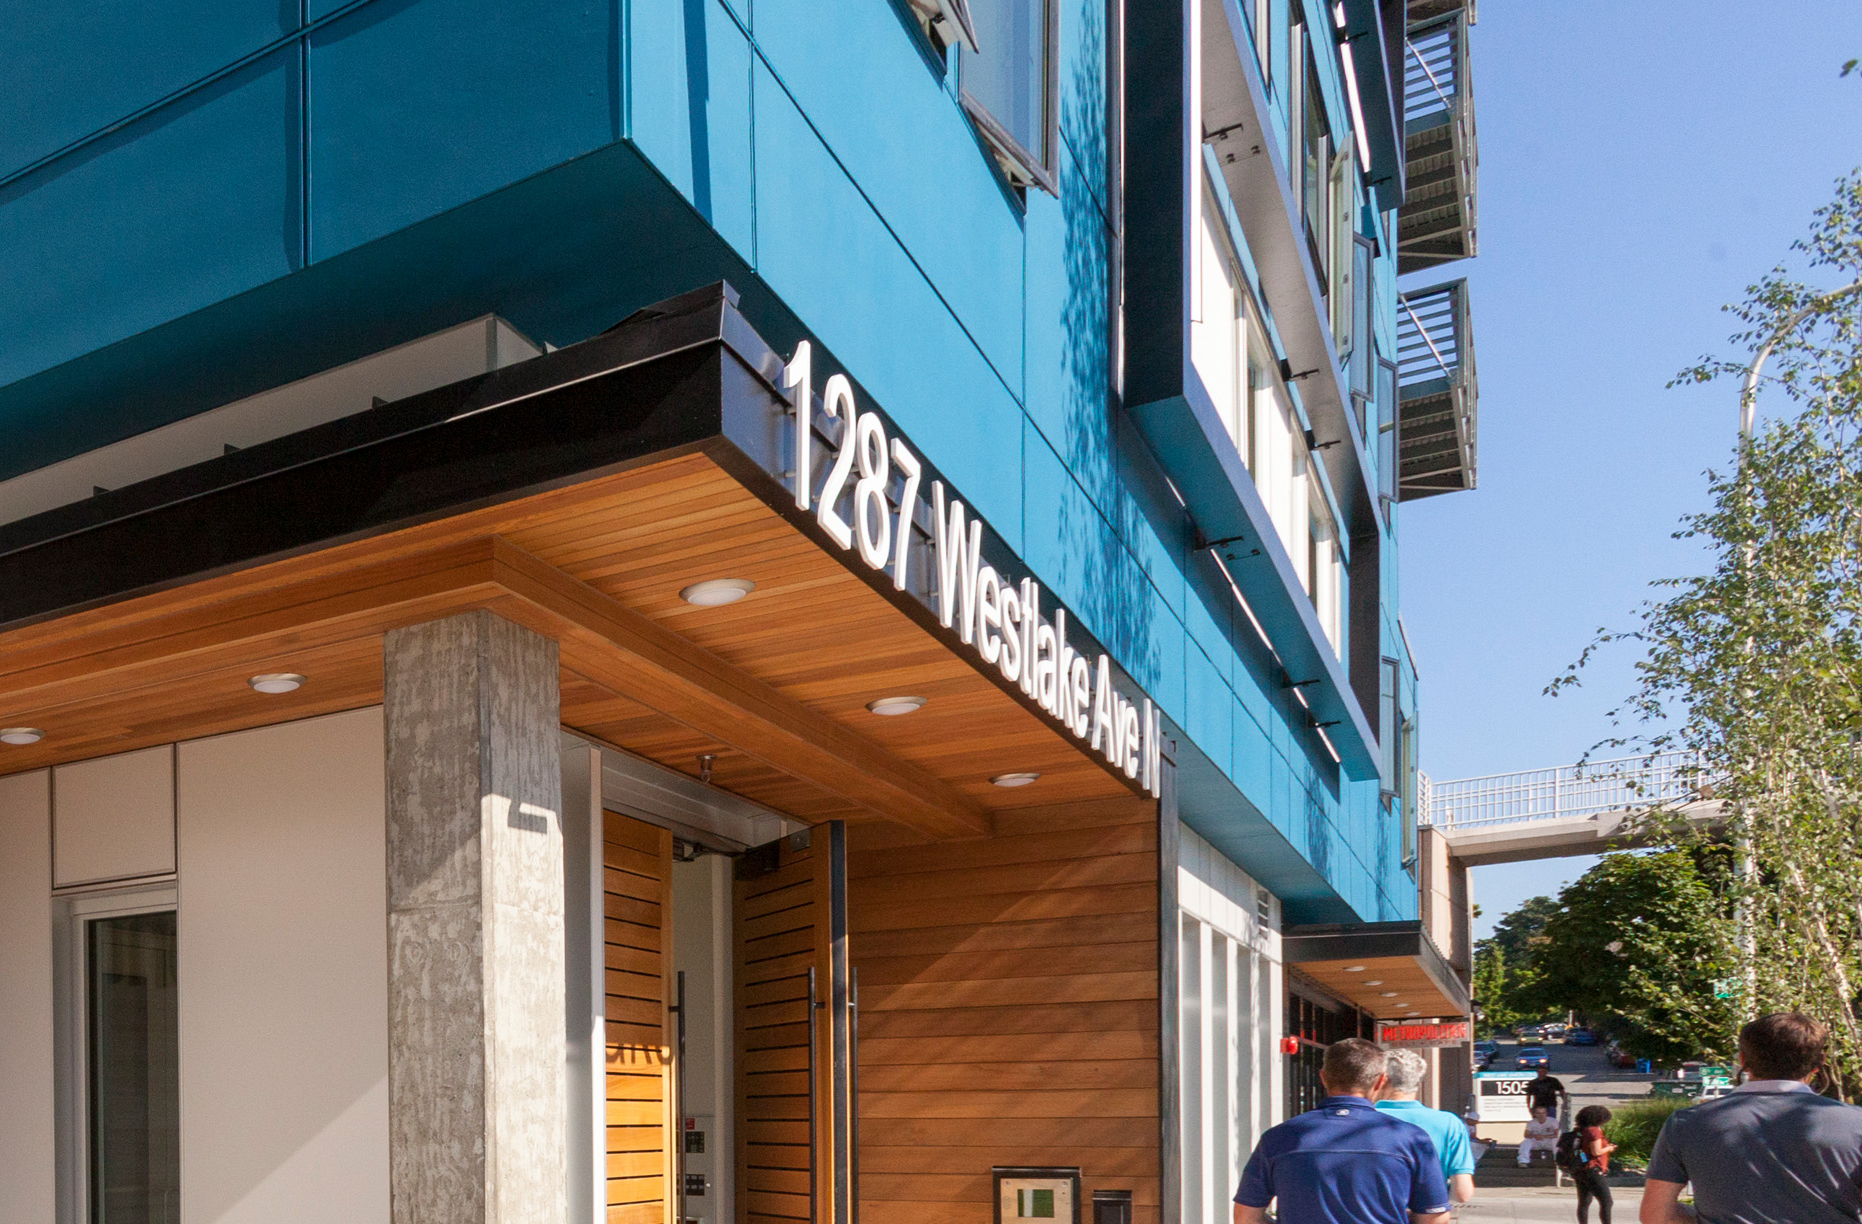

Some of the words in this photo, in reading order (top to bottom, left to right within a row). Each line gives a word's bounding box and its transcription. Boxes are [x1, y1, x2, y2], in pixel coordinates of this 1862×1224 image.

[783, 339, 922, 591] 1287
[931, 480, 1090, 739] Westlake
[1091, 654, 1140, 779] Ave
[1142, 698, 1162, 799] N
[1382, 1023, 1466, 1041] METROPOLITAN
[1495, 1081, 1529, 1095] 1505
